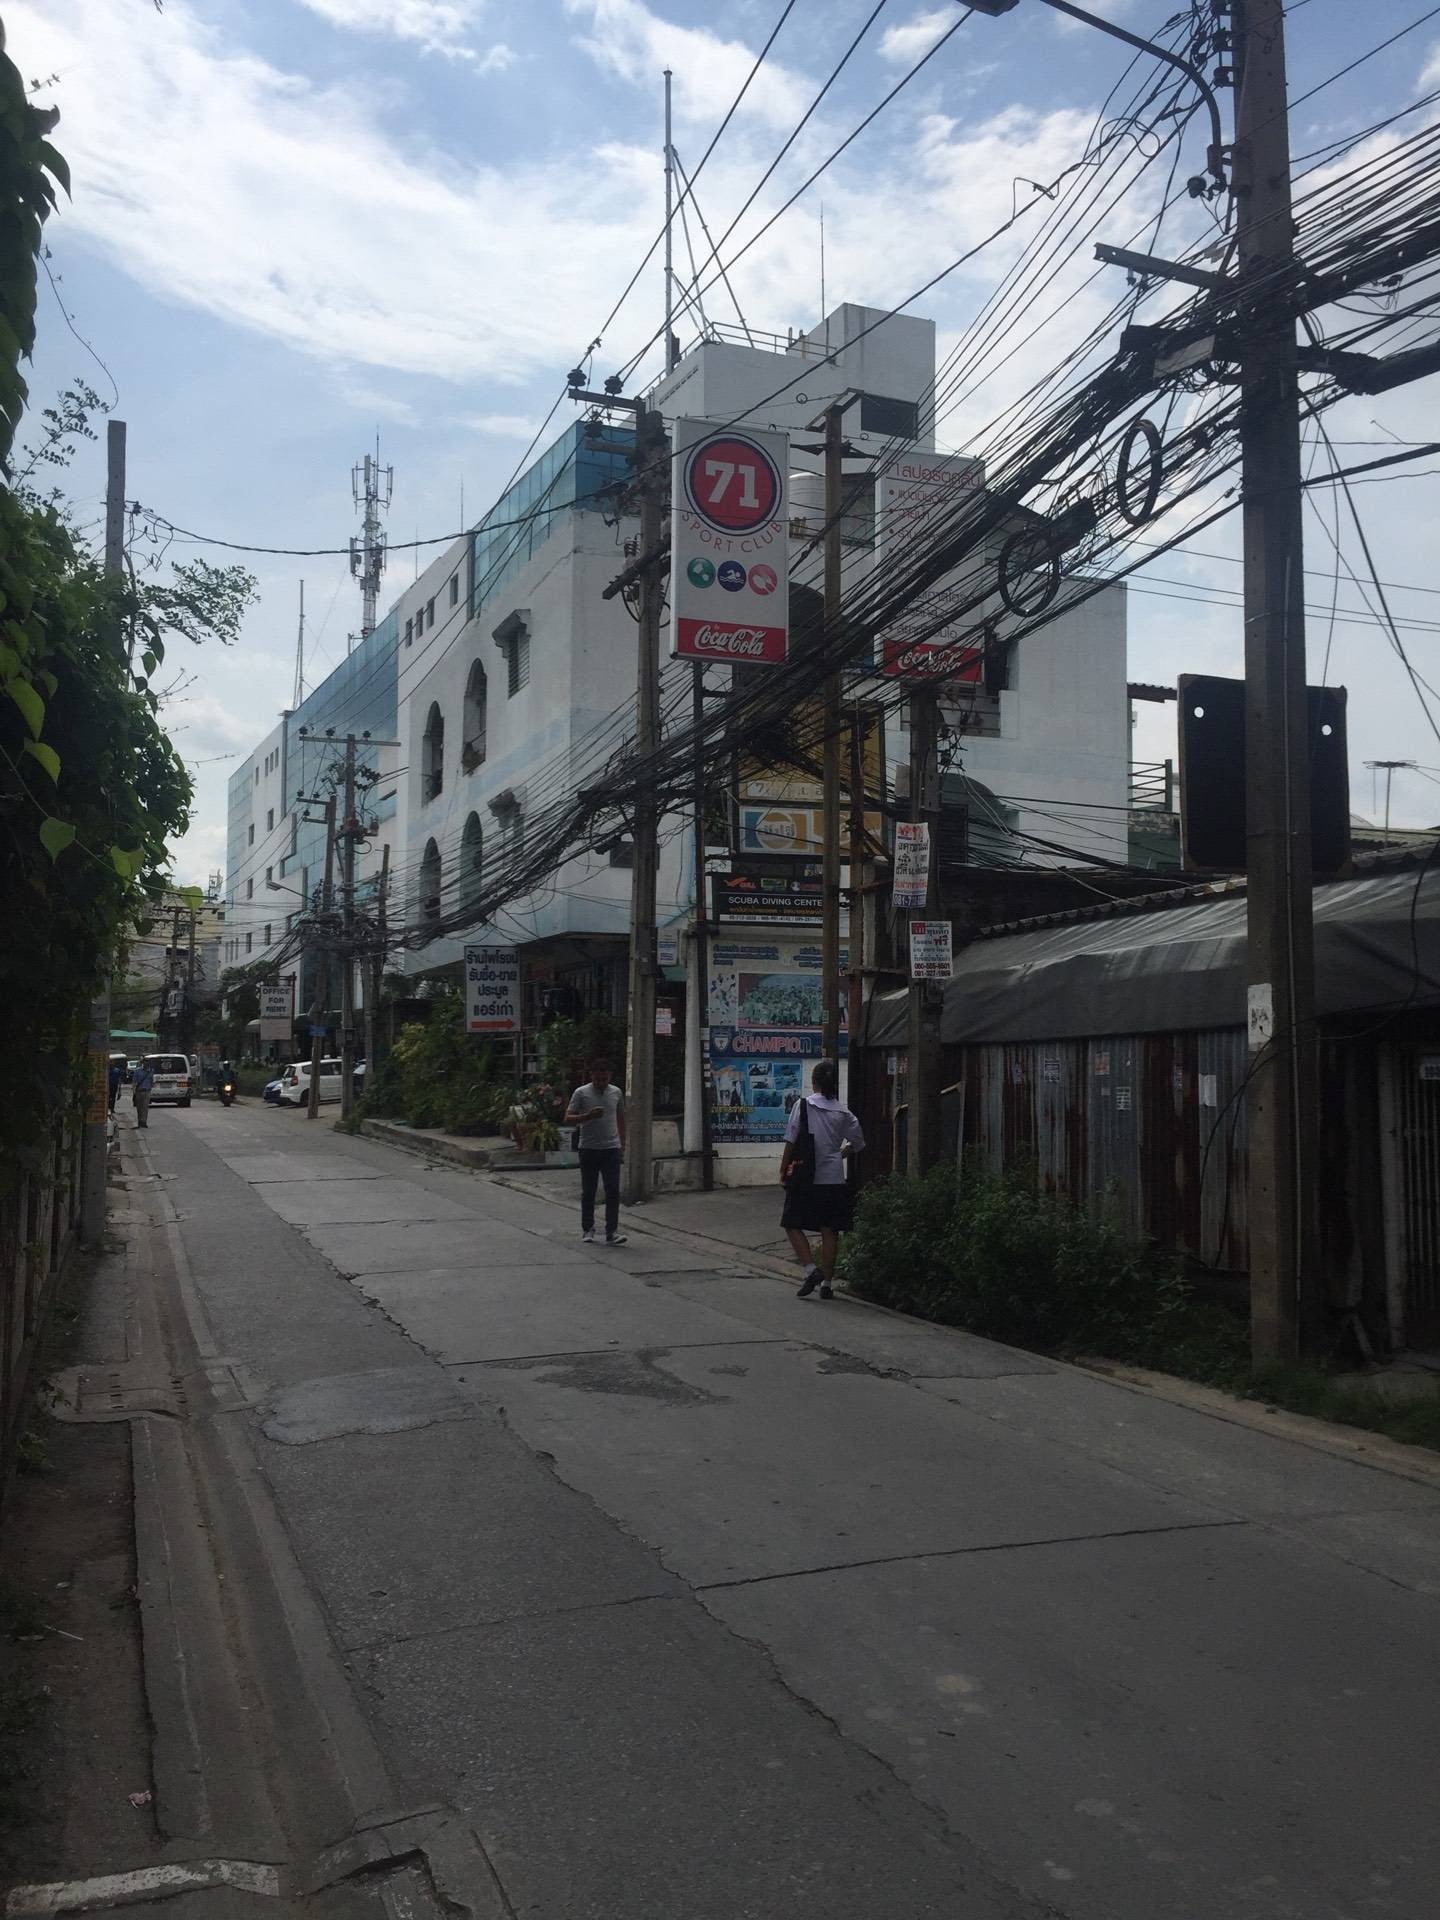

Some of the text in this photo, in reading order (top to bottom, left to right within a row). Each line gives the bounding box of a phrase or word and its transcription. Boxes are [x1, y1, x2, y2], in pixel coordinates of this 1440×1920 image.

[705, 459, 759, 509] 71
[681, 511, 782, 553] SPORT CLUB
[728, 896, 823, 907] SCUBA DIVING CENTE
[474, 1000, 514, 1016] แอร์เก่า
